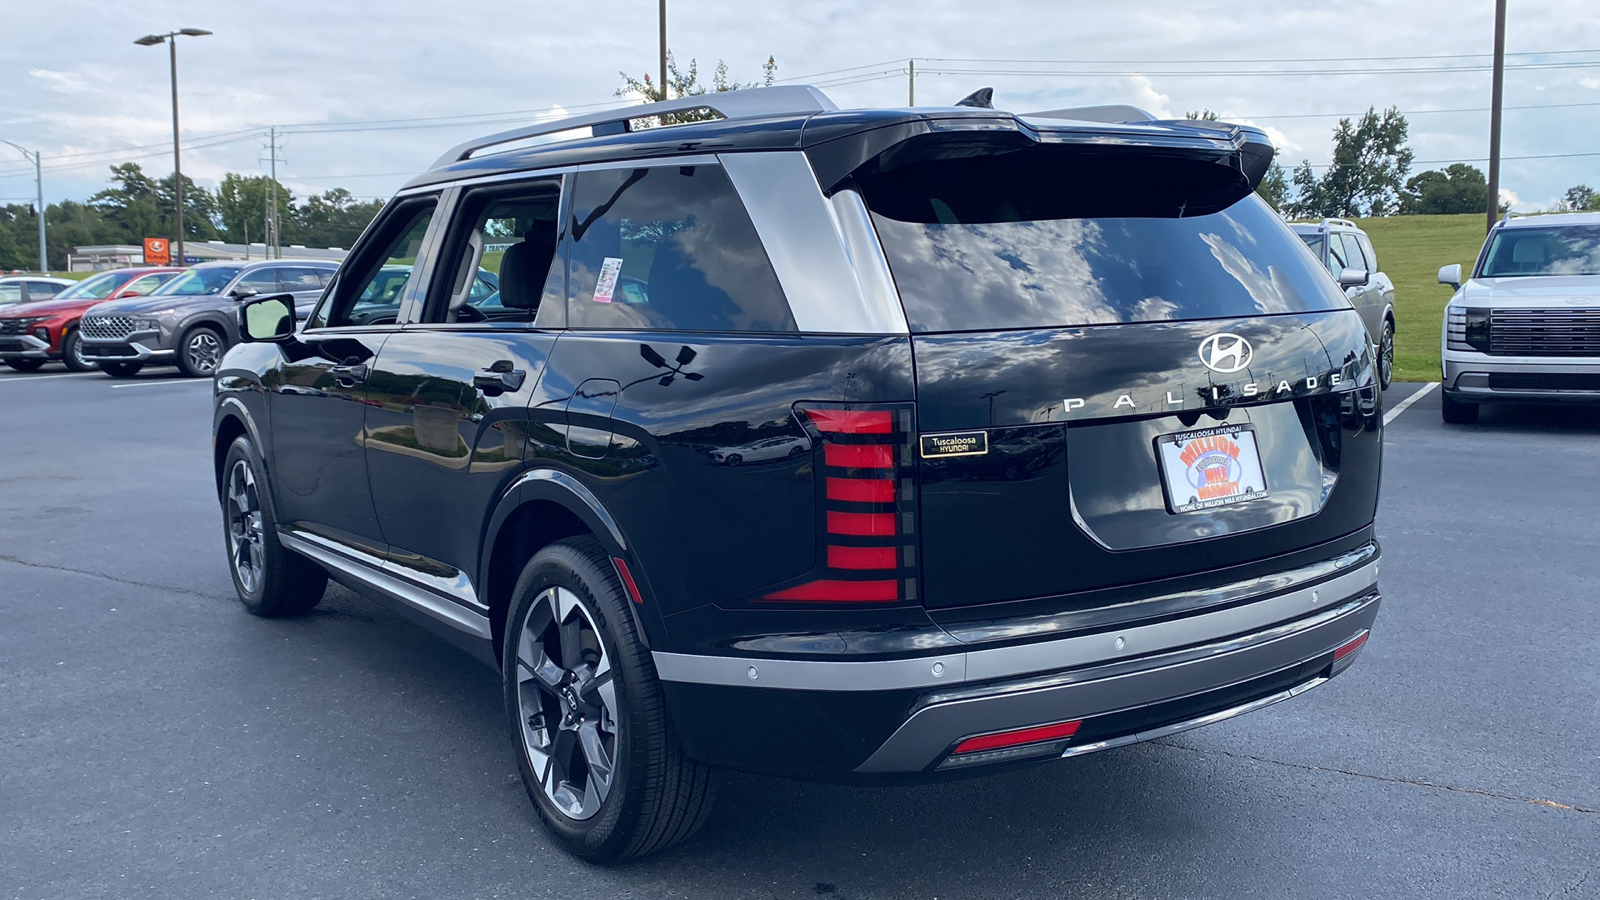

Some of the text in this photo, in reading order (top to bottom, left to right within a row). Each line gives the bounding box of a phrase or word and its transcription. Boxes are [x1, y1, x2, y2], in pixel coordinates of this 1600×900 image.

[1063, 373, 1341, 413] PALISADE
[932, 436, 976, 446] Tuscaloosa
[1175, 426, 1242, 441] TUSCALOOSA HYUNDAI
[939, 444, 969, 453] HYUNDAI
[1179, 435, 1240, 468] MILLION
[1203, 466, 1229, 484] MILE
[1197, 481, 1240, 500] WARRANTY
[1179, 503, 1196, 513] HOME
[1196, 502, 1204, 510] OF
[1204, 499, 1224, 509] MILLION
[1224, 496, 1236, 505] MILE
[570, 569, 607, 630] KUMHO
